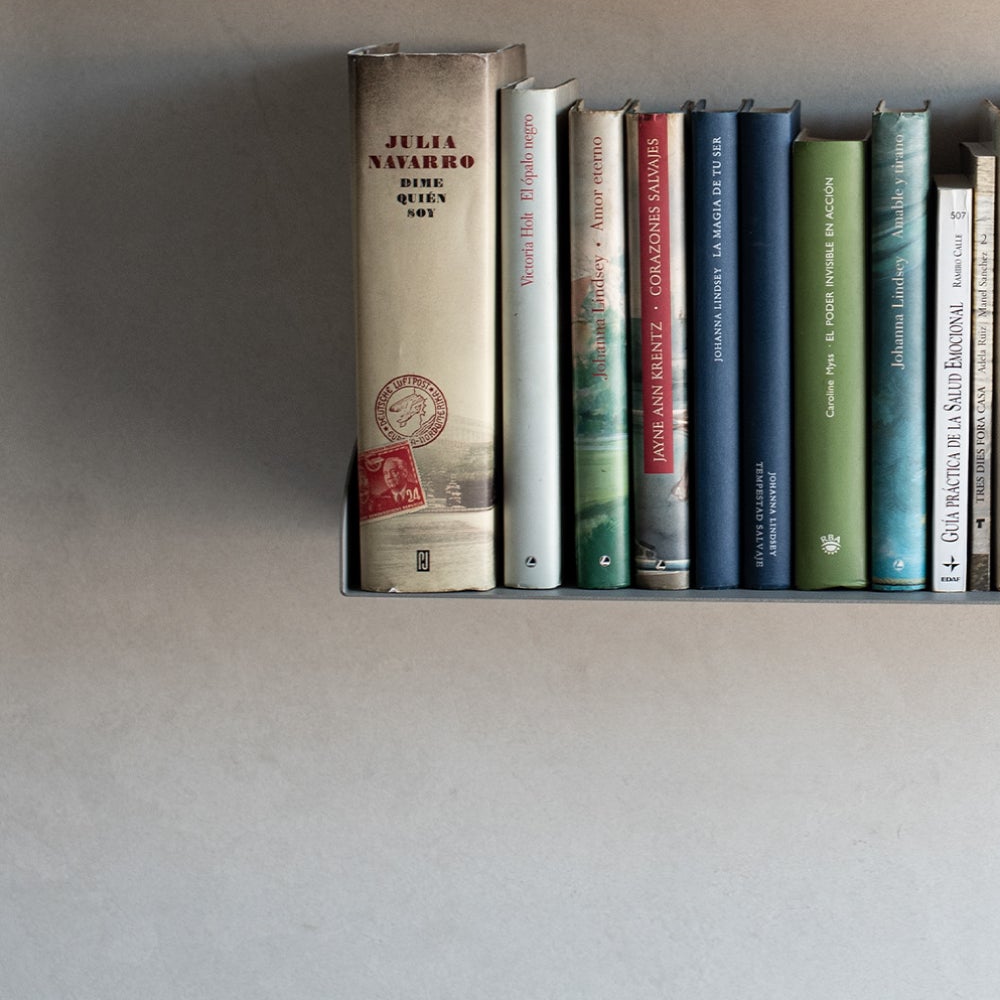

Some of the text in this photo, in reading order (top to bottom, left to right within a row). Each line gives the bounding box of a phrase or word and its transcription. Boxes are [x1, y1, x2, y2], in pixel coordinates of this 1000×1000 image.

[368, 155, 475, 169] NAVARRO
[385, 135, 457, 149] JULIA
[397, 192, 447, 204] QUIÉN
[400, 177, 444, 188] DIME
[407, 209, 435, 218] SOY
[519, 113, 537, 287] Victoria Holt ópalo negro
[950, 211, 966, 220] 507
[589, 136, 609, 380] Johanna Lindsey Amor eterno
[712, 199, 723, 362] JOHANNA LINDSEY MAGIA
[822, 177, 835, 326] PODER INVISIBLE ACCIÓN
[890, 134, 908, 369] Johanna Lindsey Amable tirano
[646, 138, 667, 462] JAYNE ANN KRENTZ CORAZONES SALVAJES
[978, 291, 988, 317] Manel
[825, 353, 837, 418] Caroline Myss
[976, 386, 986, 503] TRES DIES FORA CASA
[755, 461, 764, 567] TEMPESTAD SALVAJE
[819, 535, 840, 544] RBA
